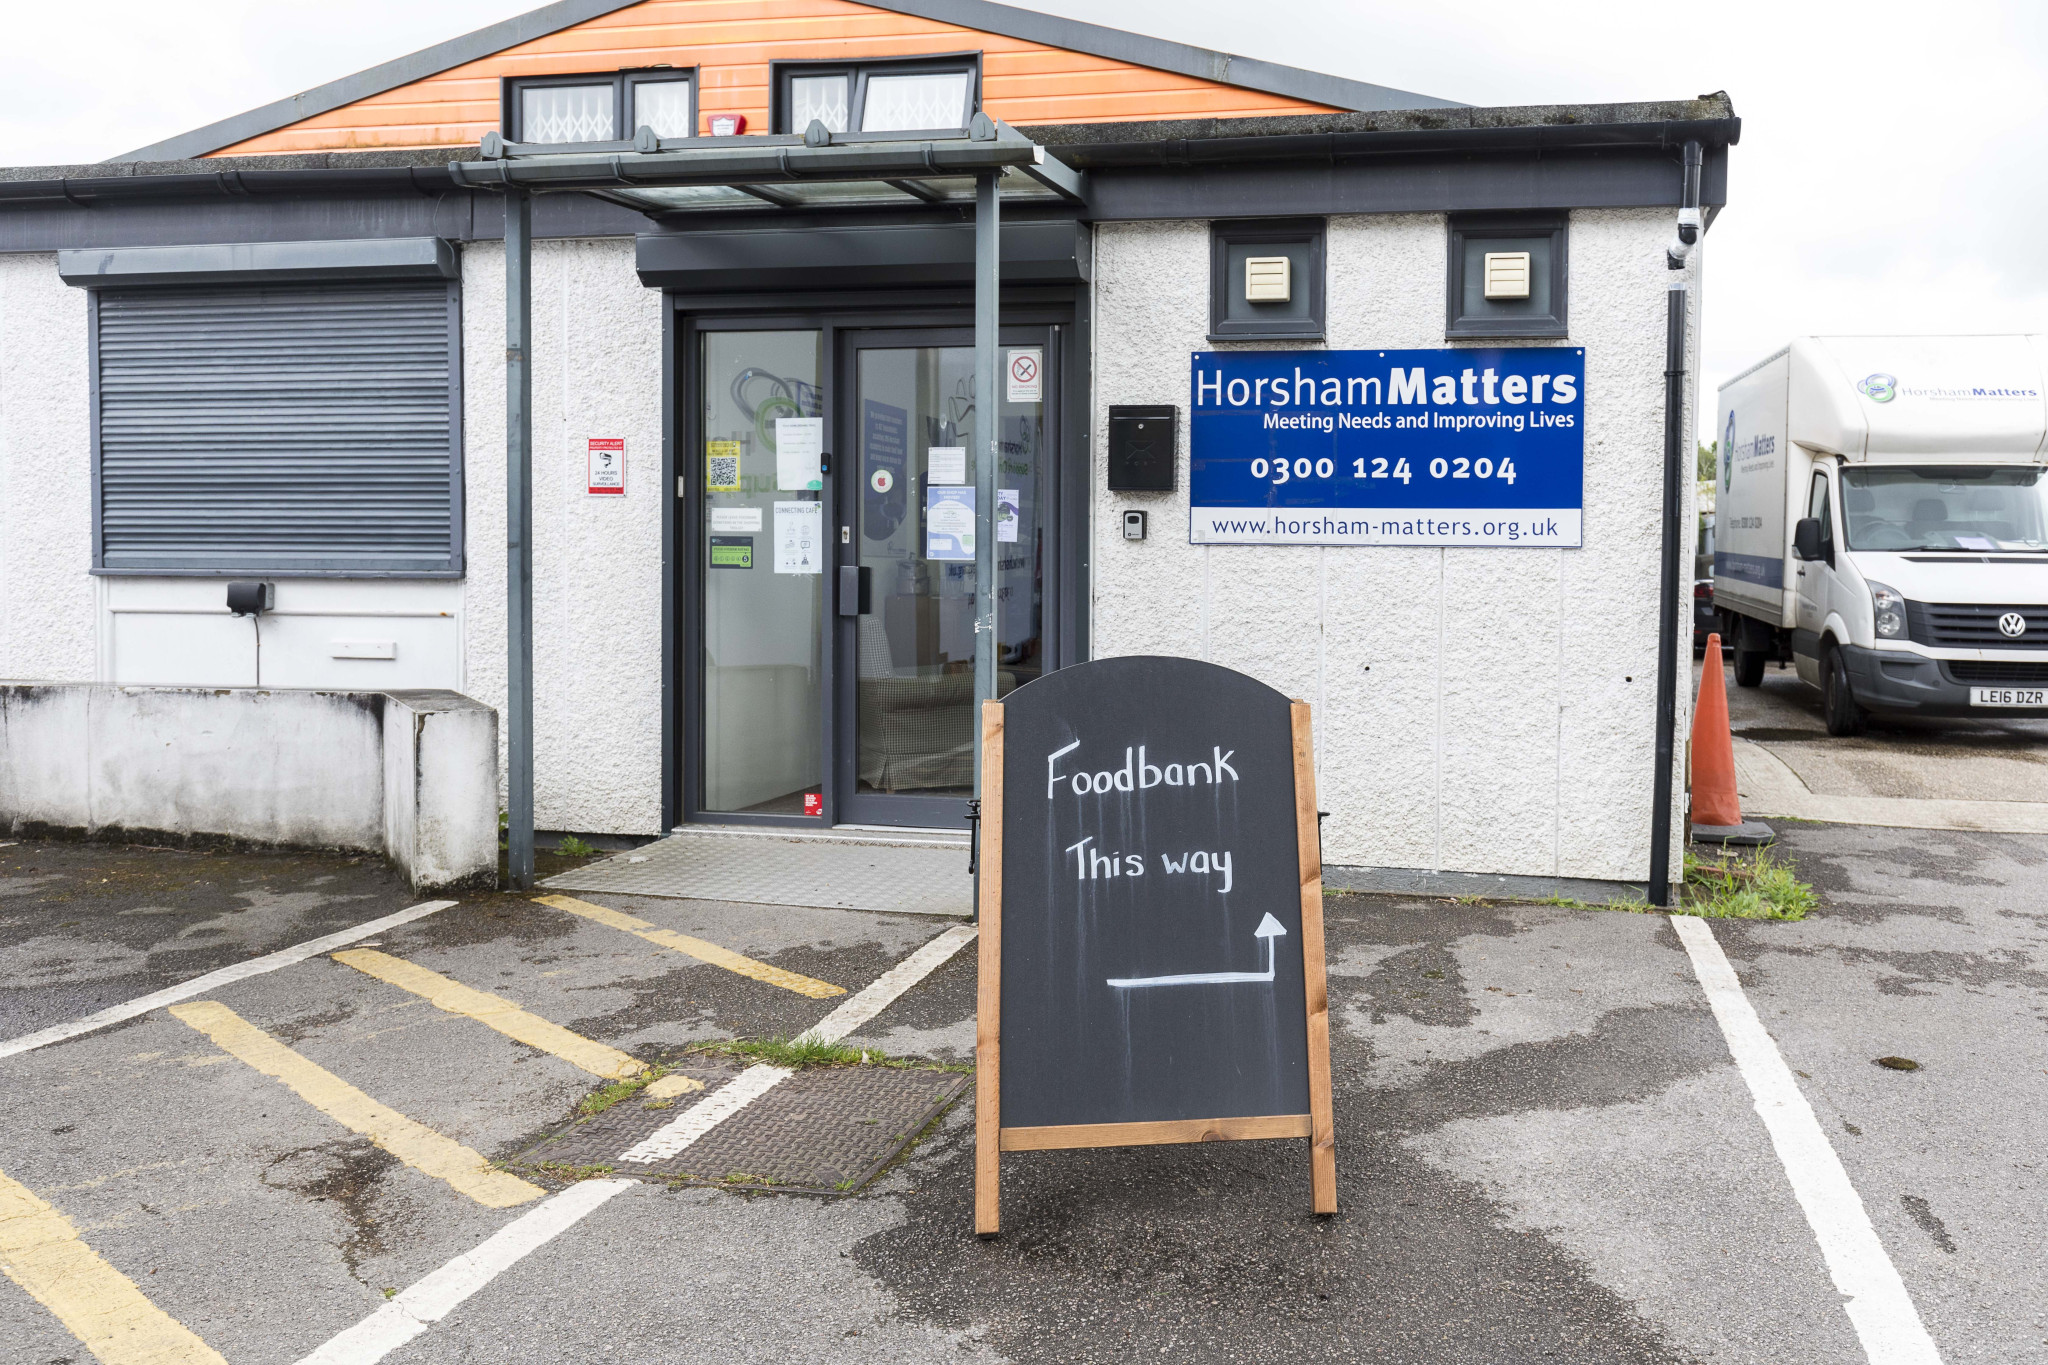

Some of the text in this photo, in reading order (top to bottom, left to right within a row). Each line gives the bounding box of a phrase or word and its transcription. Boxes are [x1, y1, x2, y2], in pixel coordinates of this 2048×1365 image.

[1263, 411, 1574, 433] Meeting Needs and Improving Lives
[1250, 457, 1517, 485] 0300 124 0204
[1212, 516, 1559, 539] www.horsham-matters.org.uk
[1980, 690, 2043, 704] LE16 DZR
[1047, 739, 1239, 799] Foodbank
[1065, 836, 1233, 893] This way
